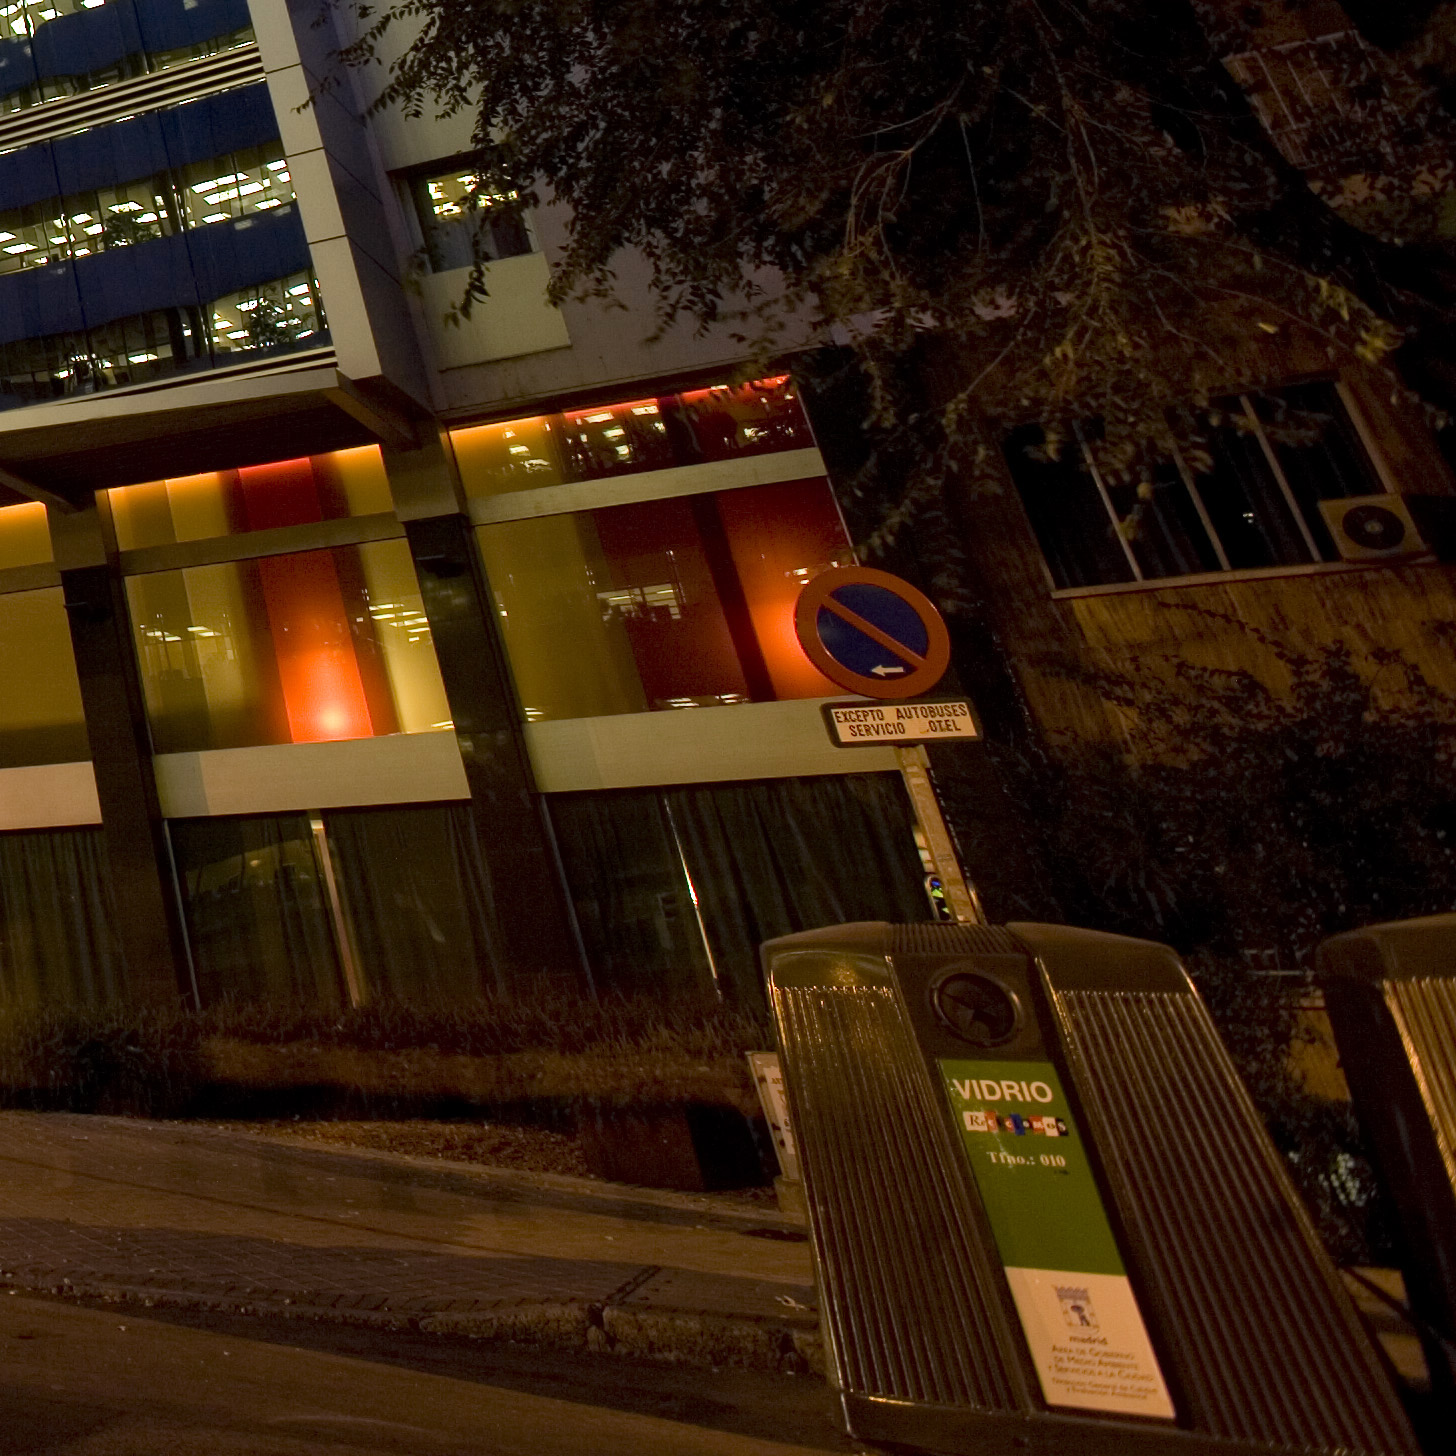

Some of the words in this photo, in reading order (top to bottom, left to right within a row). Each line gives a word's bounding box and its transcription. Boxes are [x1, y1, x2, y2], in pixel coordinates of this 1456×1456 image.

[833, 708, 885, 724] EXCEPTO
[896, 703, 968, 721] AUTOBUSES
[848, 722, 906, 738] SERVICIO
[919, 719, 962, 735] OTEL
[951, 1078, 1053, 1103] VIDRIO
[1039, 1154, 1067, 1167] 010
